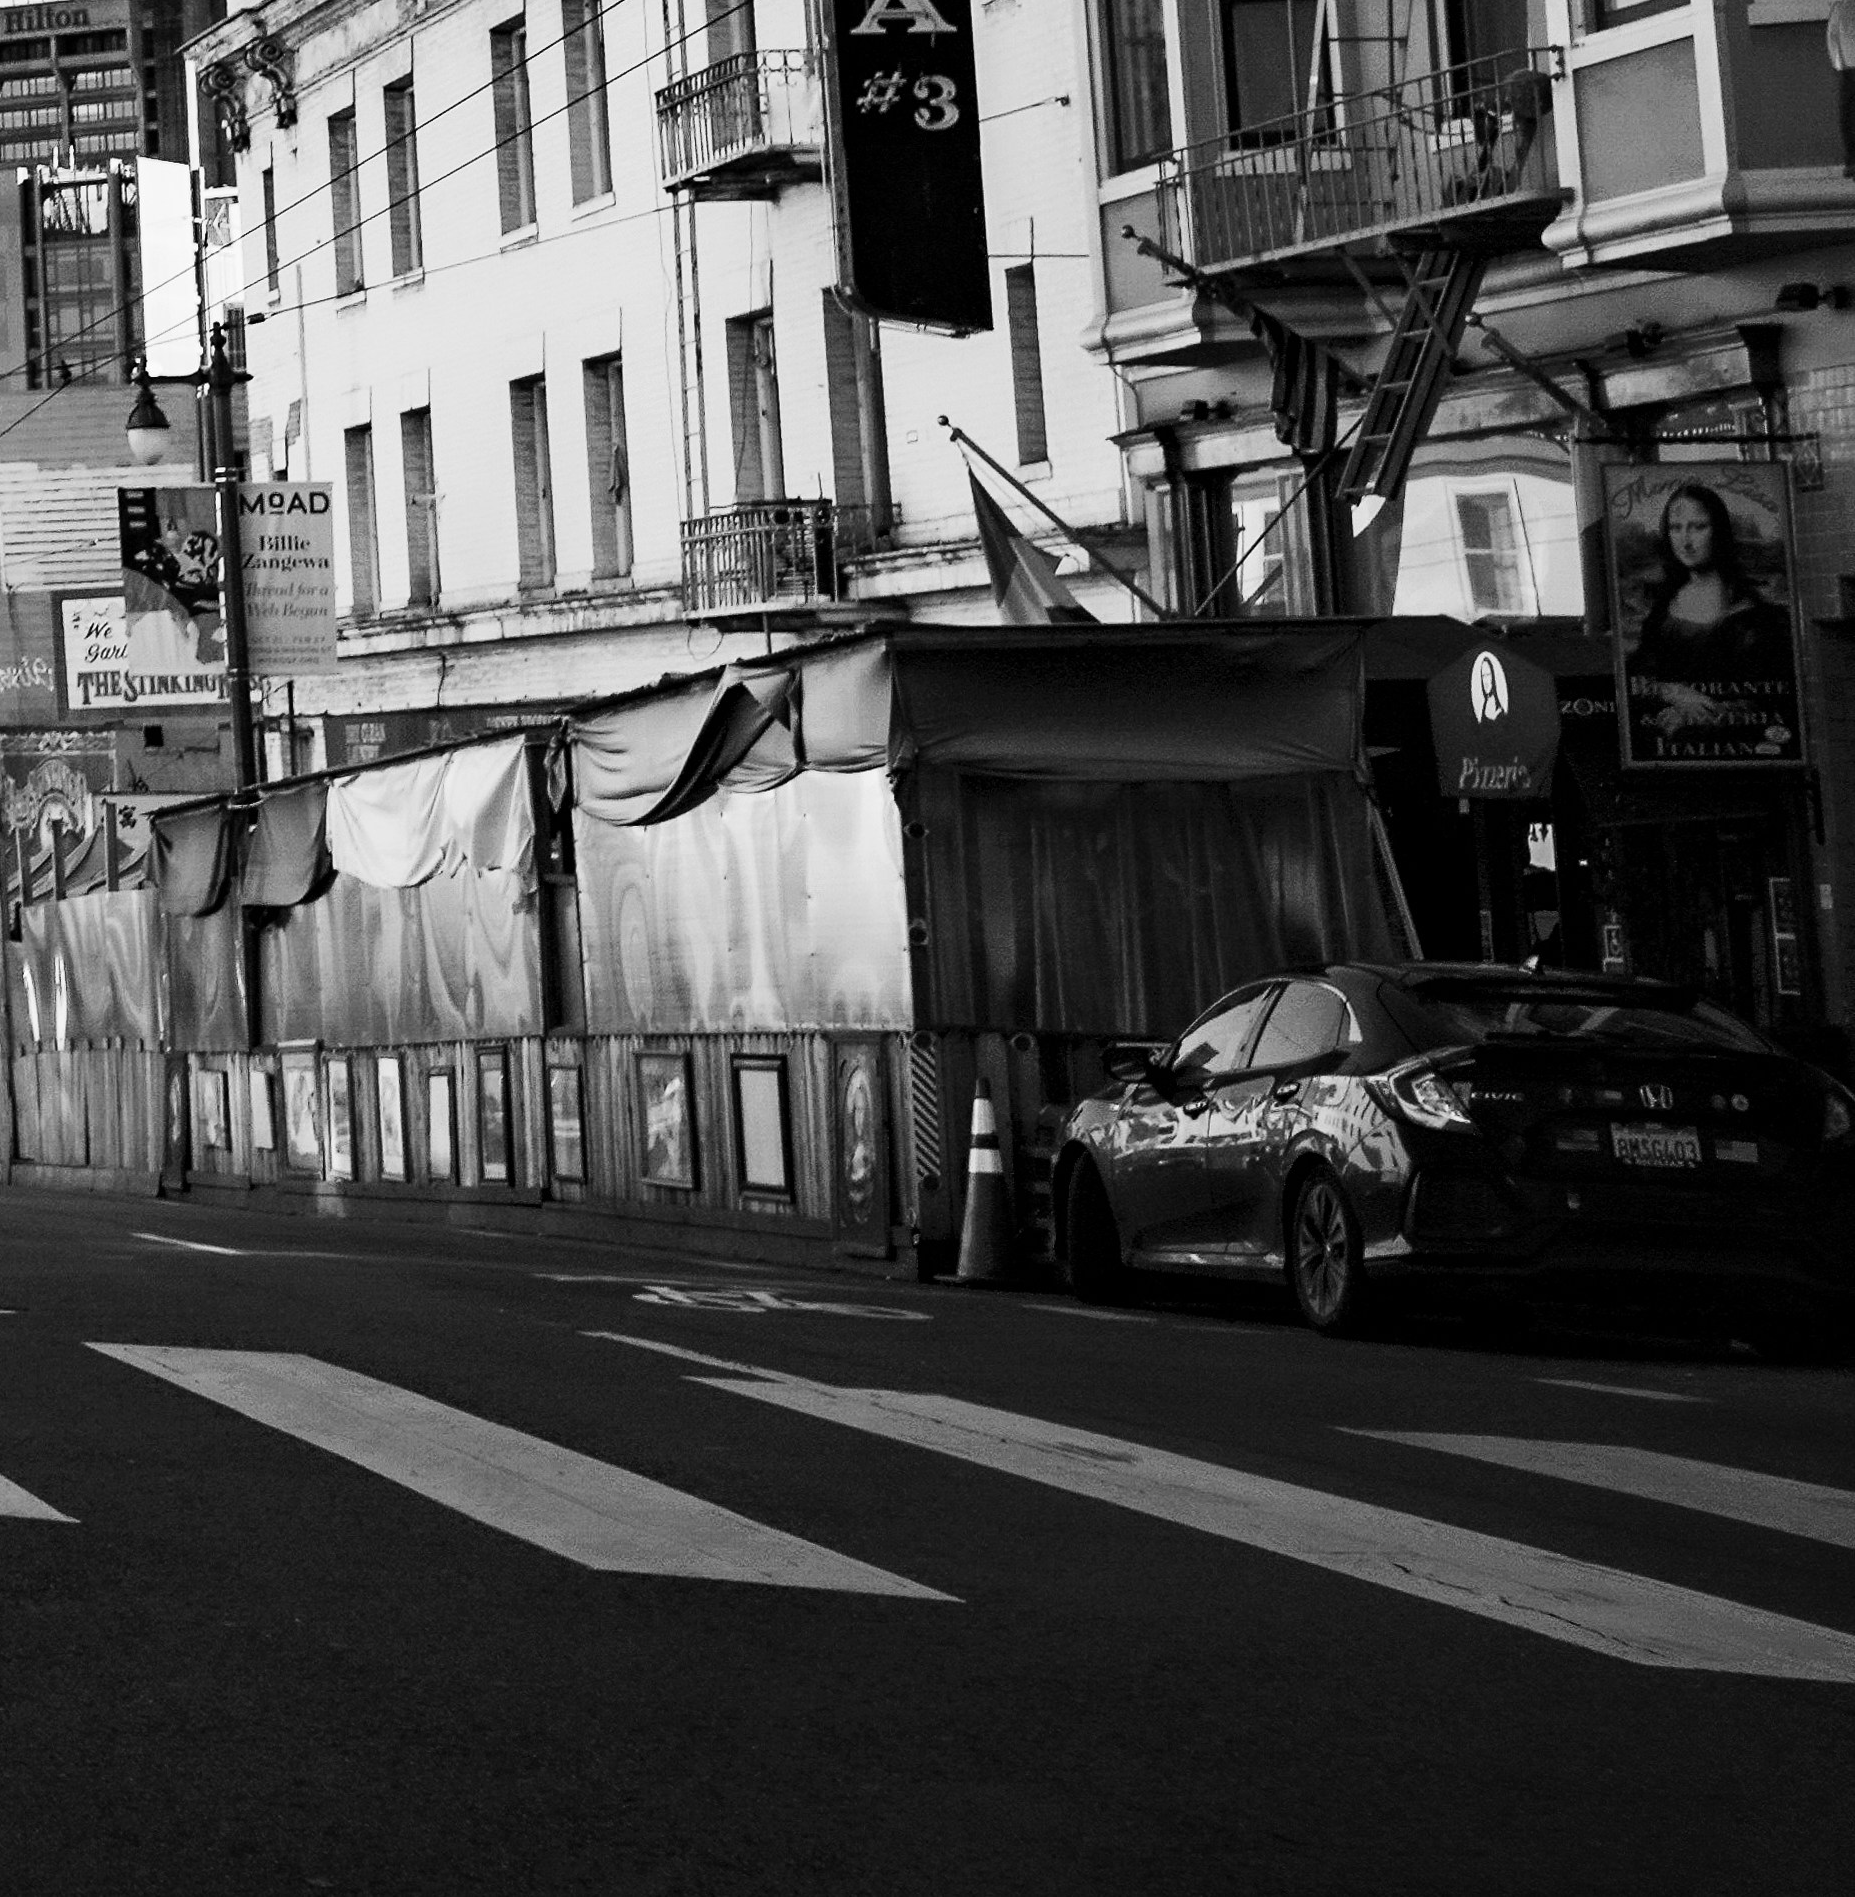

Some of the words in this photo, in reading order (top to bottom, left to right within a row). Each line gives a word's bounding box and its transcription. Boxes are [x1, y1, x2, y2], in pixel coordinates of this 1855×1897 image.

[3, 6, 89, 35] Hilton
[258, 535, 311, 552] Billie
[242, 554, 330, 572] Zangewa
[84, 621, 113, 640] We
[84, 643, 128, 663] Garl
[77, 671, 122, 706] THE
[1459, 755, 1532, 790] Pizzeria
